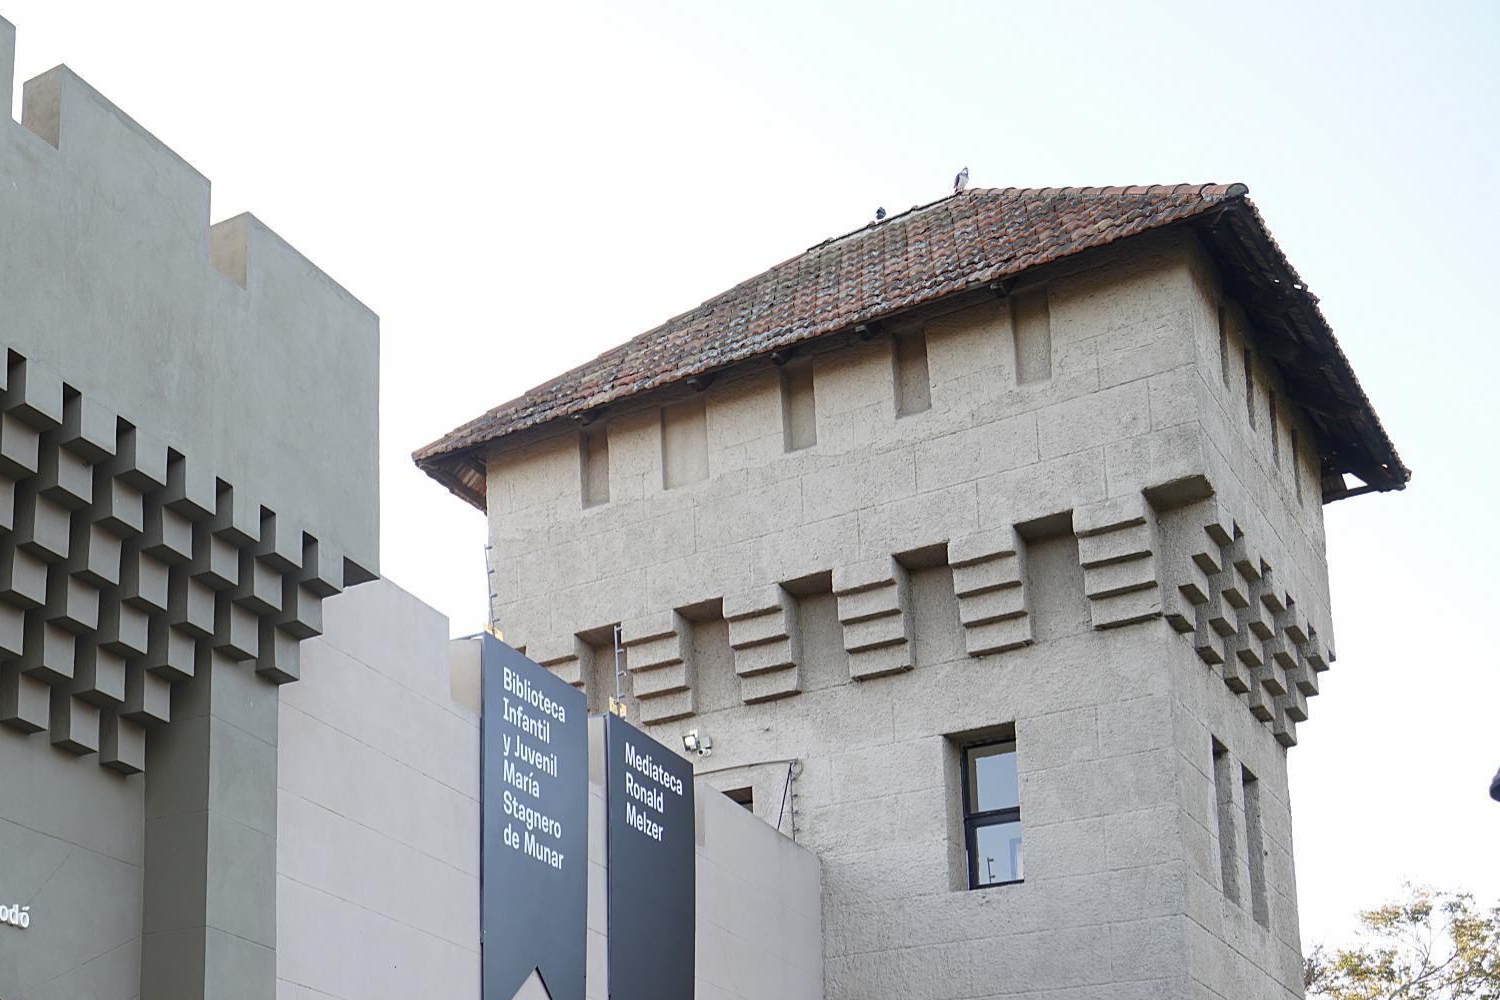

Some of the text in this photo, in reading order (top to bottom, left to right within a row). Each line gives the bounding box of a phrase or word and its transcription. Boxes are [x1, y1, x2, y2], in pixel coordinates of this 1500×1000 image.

[503, 666, 566, 724] Biblioteca
[502, 697, 551, 745] Infantil
[503, 733, 558, 778] y Juvenil
[503, 759, 540, 799] María
[625, 741, 683, 797] Mediateca
[503, 790, 562, 839] Stagnero
[625, 772, 664, 814] Ronald
[626, 801, 664, 842] Melzer
[503, 823, 564, 870] de Munar
